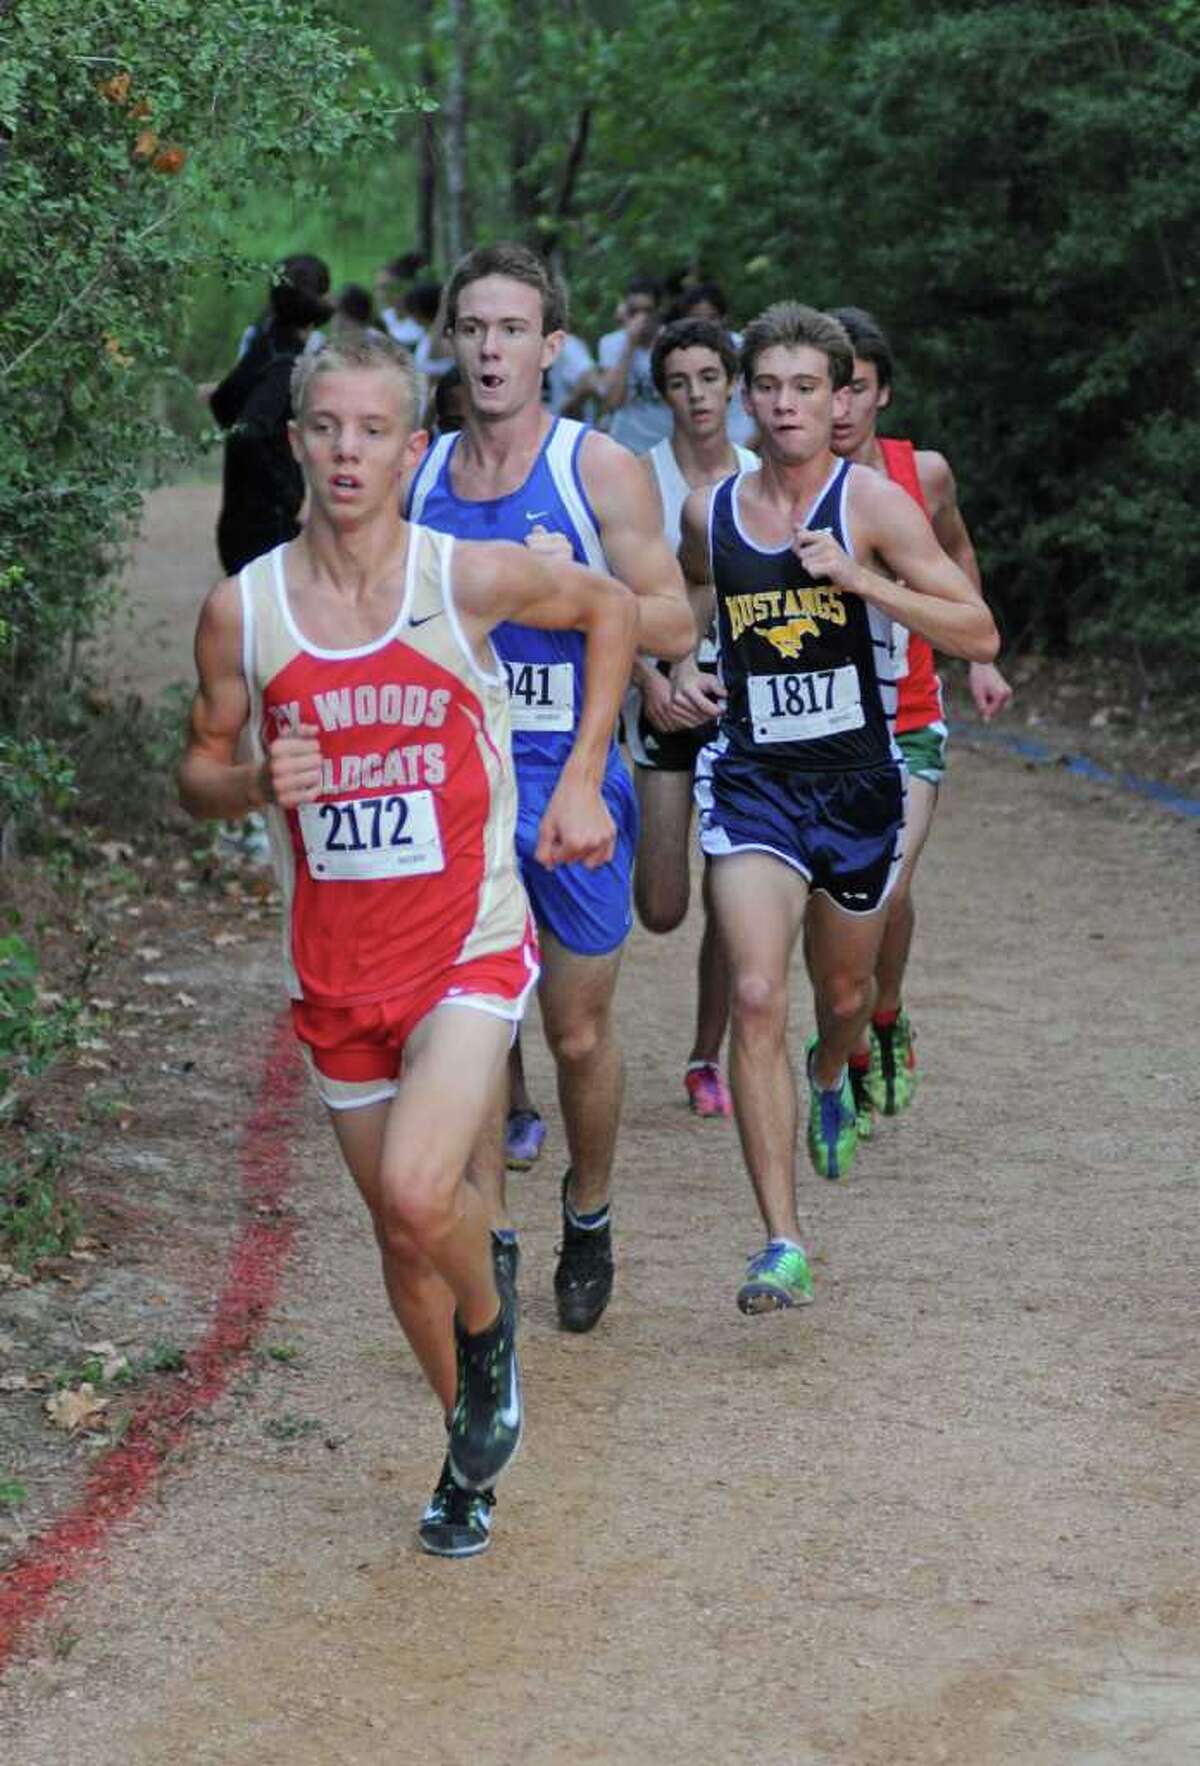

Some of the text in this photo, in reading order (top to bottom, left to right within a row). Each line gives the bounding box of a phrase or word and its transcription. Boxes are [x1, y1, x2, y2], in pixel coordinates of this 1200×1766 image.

[725, 587, 847, 640] MUSTANGS
[314, 684, 450, 732] WOODS
[766, 670, 835, 717] 1817
[322, 743, 446, 794] LDCATS
[320, 796, 413, 850] 2172
